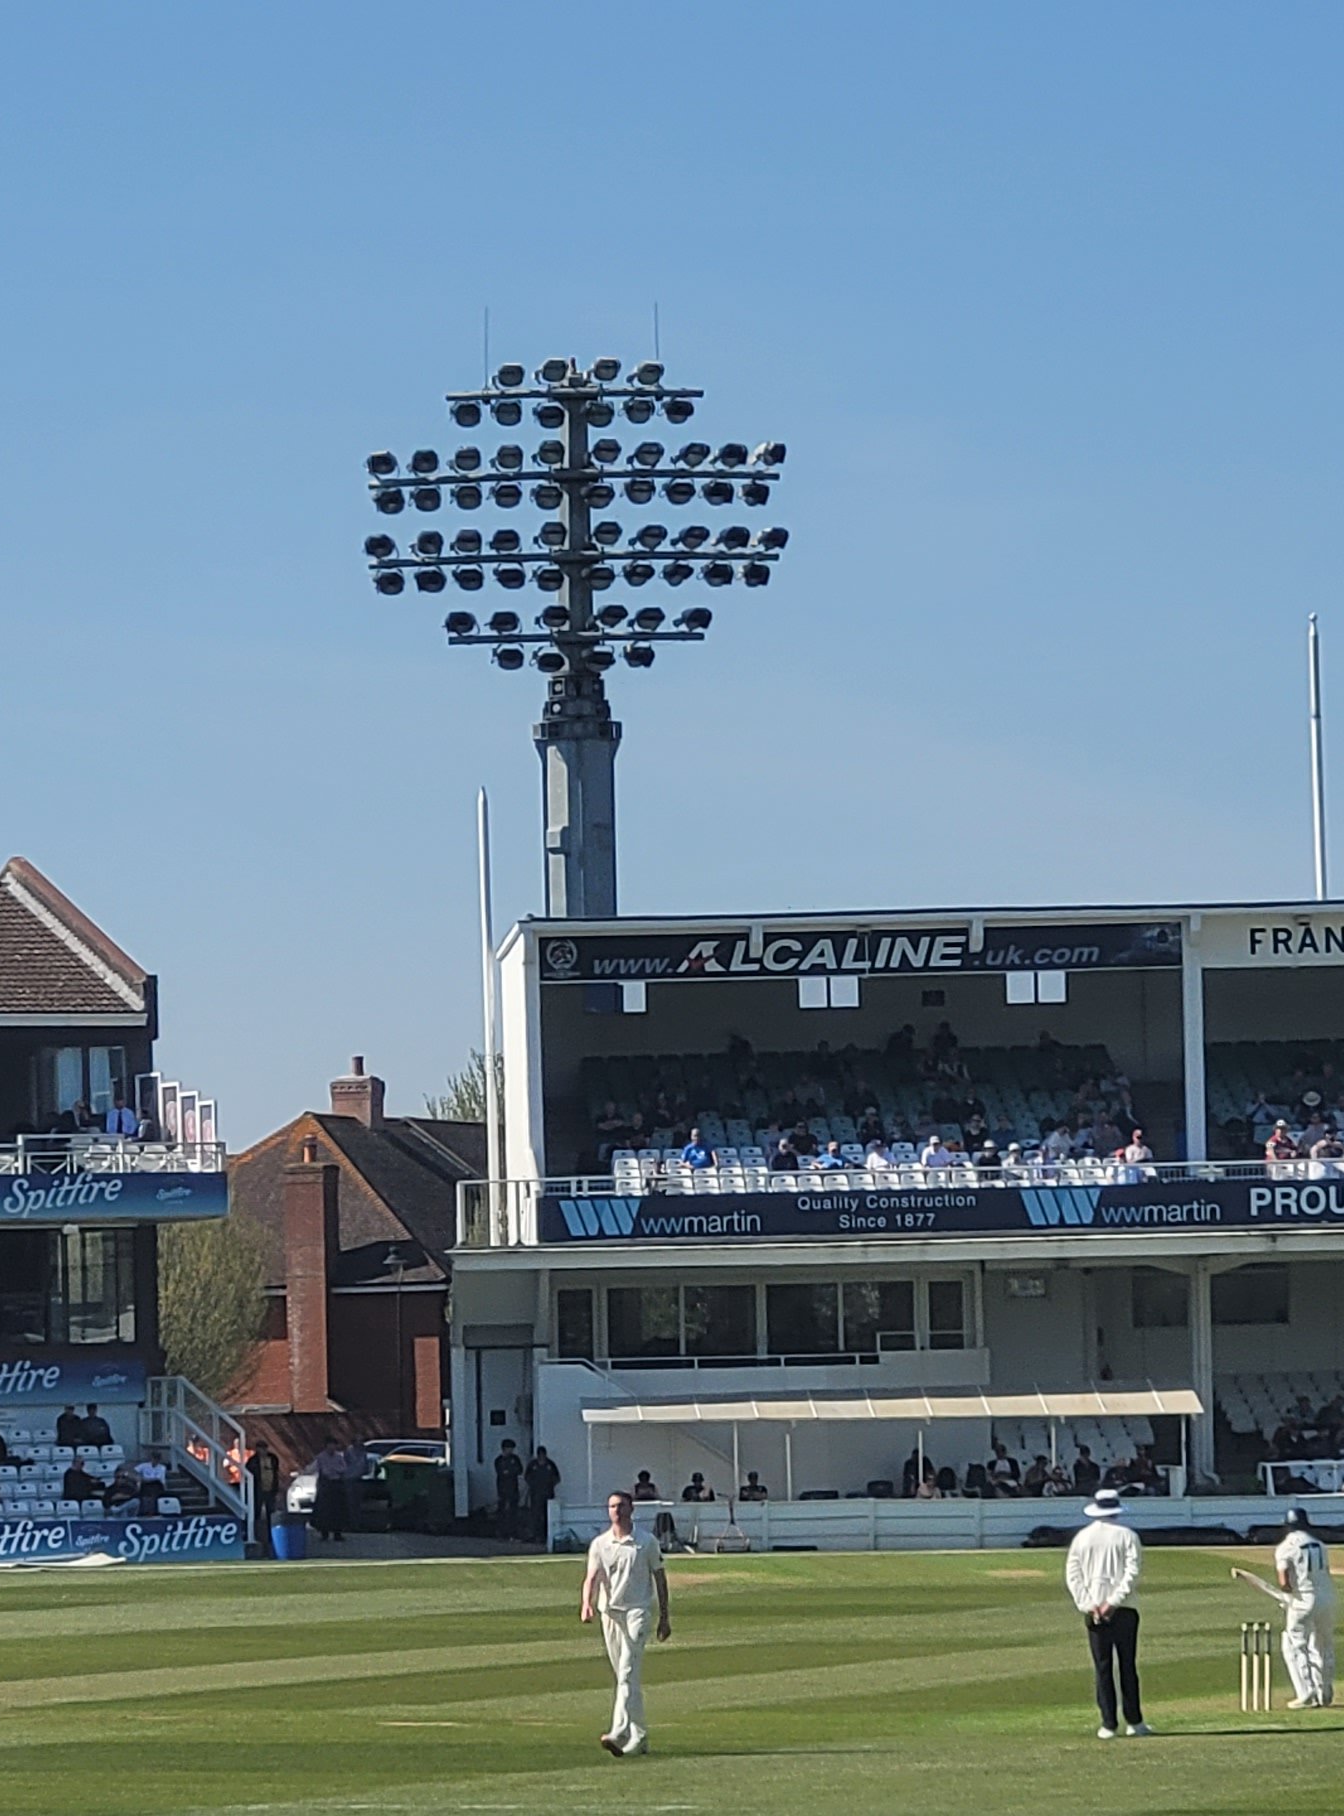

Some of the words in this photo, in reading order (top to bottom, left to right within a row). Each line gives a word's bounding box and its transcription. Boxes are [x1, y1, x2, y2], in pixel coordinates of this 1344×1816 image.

[3, 1172, 123, 1219] Spitfire
[797, 1195, 859, 1212] Quality
[865, 1194, 977, 1209] Construction
[640, 1209, 761, 1236] wwmartin
[838, 1214, 886, 1229] Since
[895, 1212, 936, 1227] 1877
[1101, 1197, 1221, 1224] wwmartin
[118, 1516, 237, 1562] Spitfire
